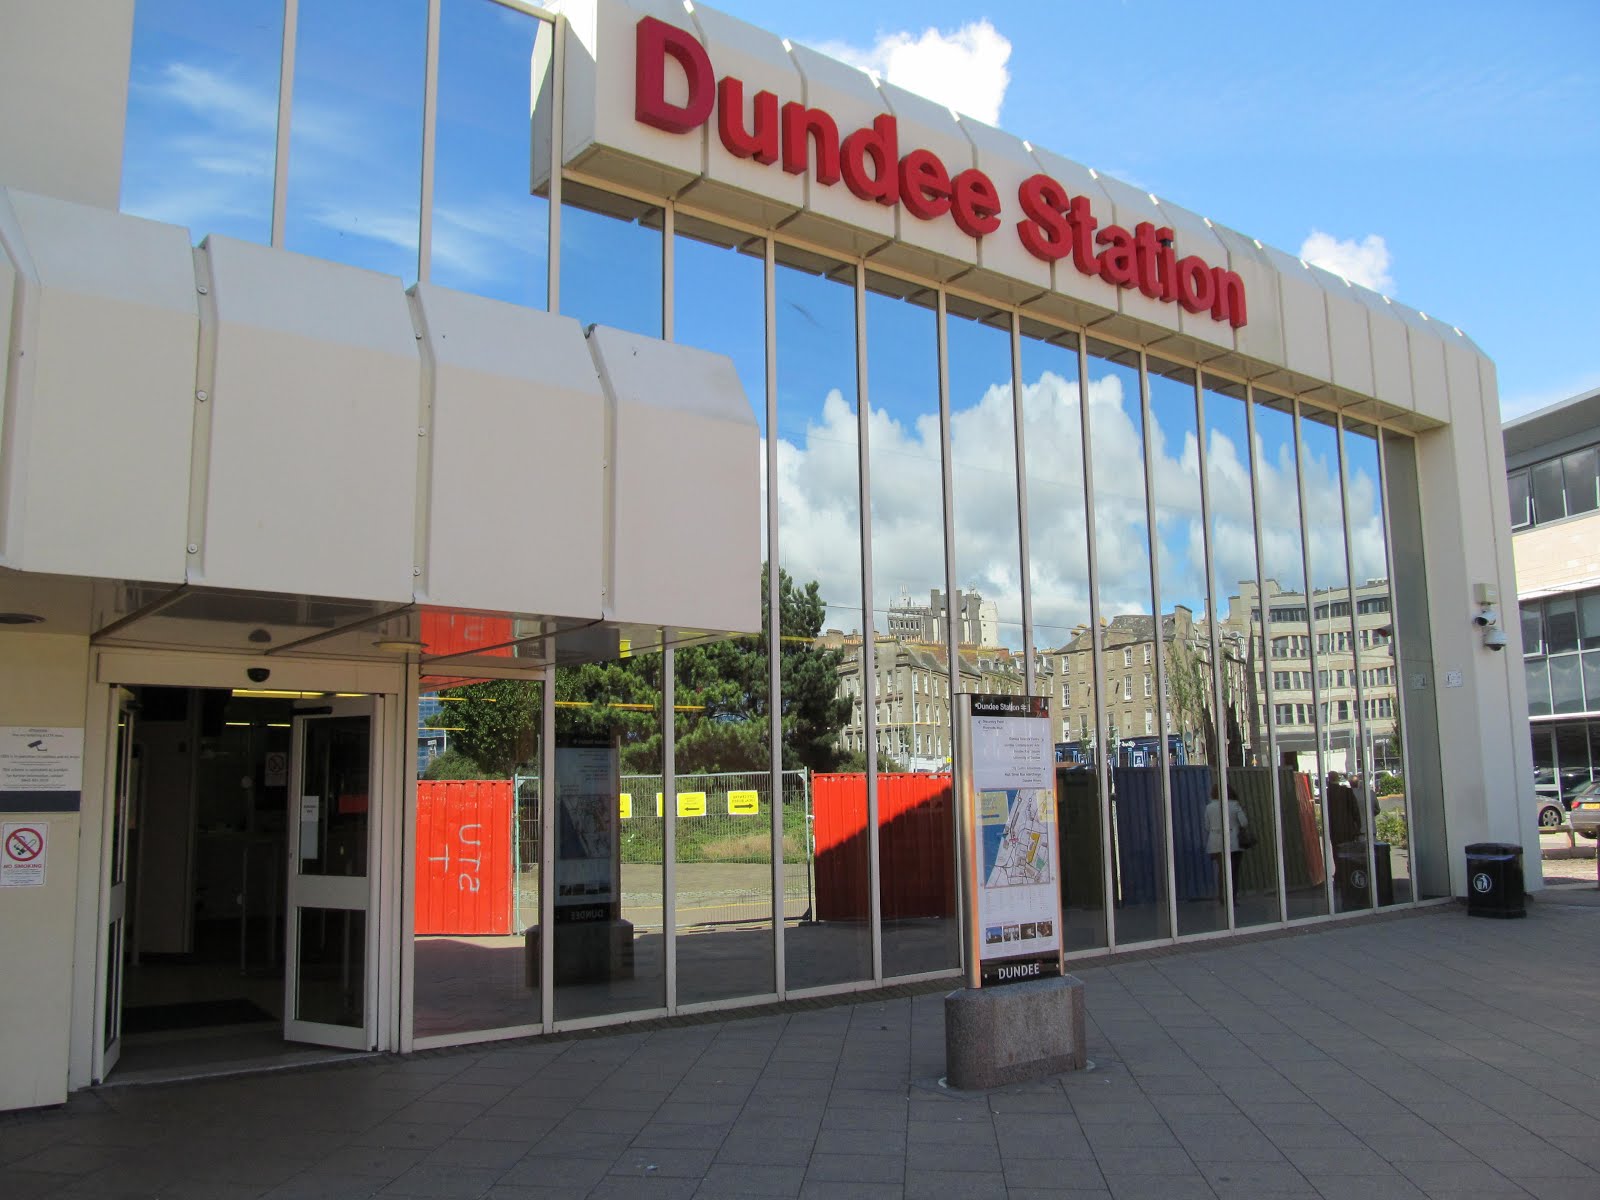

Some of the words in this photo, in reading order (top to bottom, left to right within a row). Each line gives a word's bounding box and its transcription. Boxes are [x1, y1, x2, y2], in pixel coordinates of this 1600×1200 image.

[635, 15, 1001, 238] Dundee
[1017, 172, 1247, 329] Station
[977, 702, 999, 711] Dundee
[1000, 702, 1020, 712] Station
[998, 963, 1040, 980] DUNDEE
